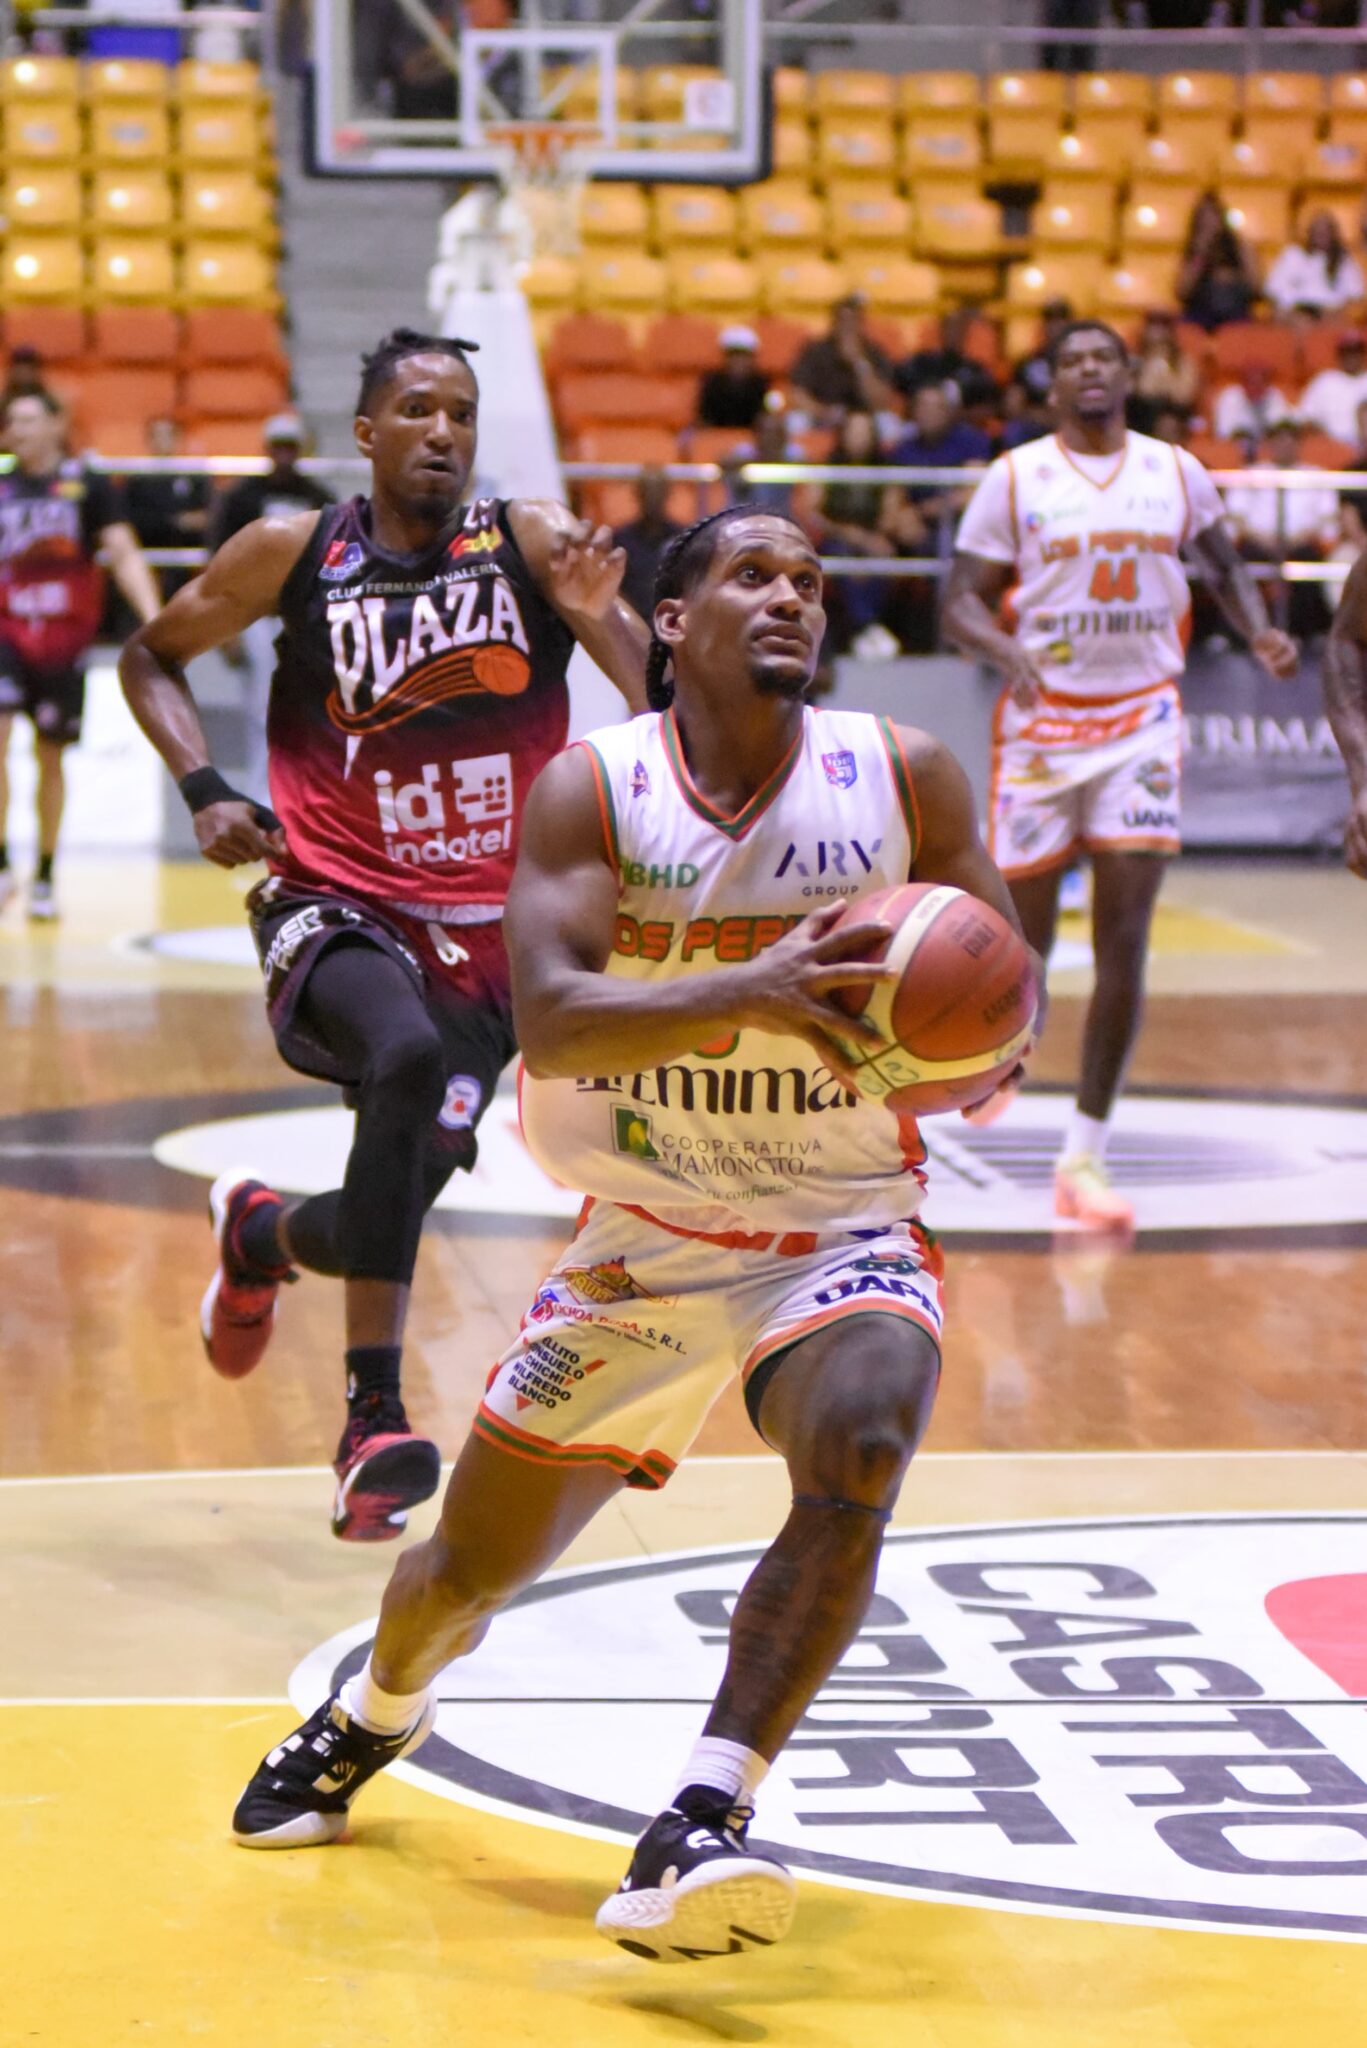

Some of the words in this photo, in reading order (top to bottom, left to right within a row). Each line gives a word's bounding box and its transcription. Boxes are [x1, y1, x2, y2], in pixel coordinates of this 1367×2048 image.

[366, 575, 440, 594] FERNAND
[1087, 558, 1141, 603] 44
[327, 577, 530, 781] PLAZA
[373, 763, 446, 833] id
[385, 819, 514, 865] indotel
[802, 886, 859, 897] GROUP
[615, 914, 674, 963] OS
[681, 914, 806, 963] PEP
[661, 1133, 823, 1155] COOPERATIVA
[512, 1361, 572, 1402] WILFREDO
[525, 1354, 565, 1385] CHICHI
[508, 1374, 557, 1409] BLANCO
[926, 1561, 1367, 1876] CASTRO
